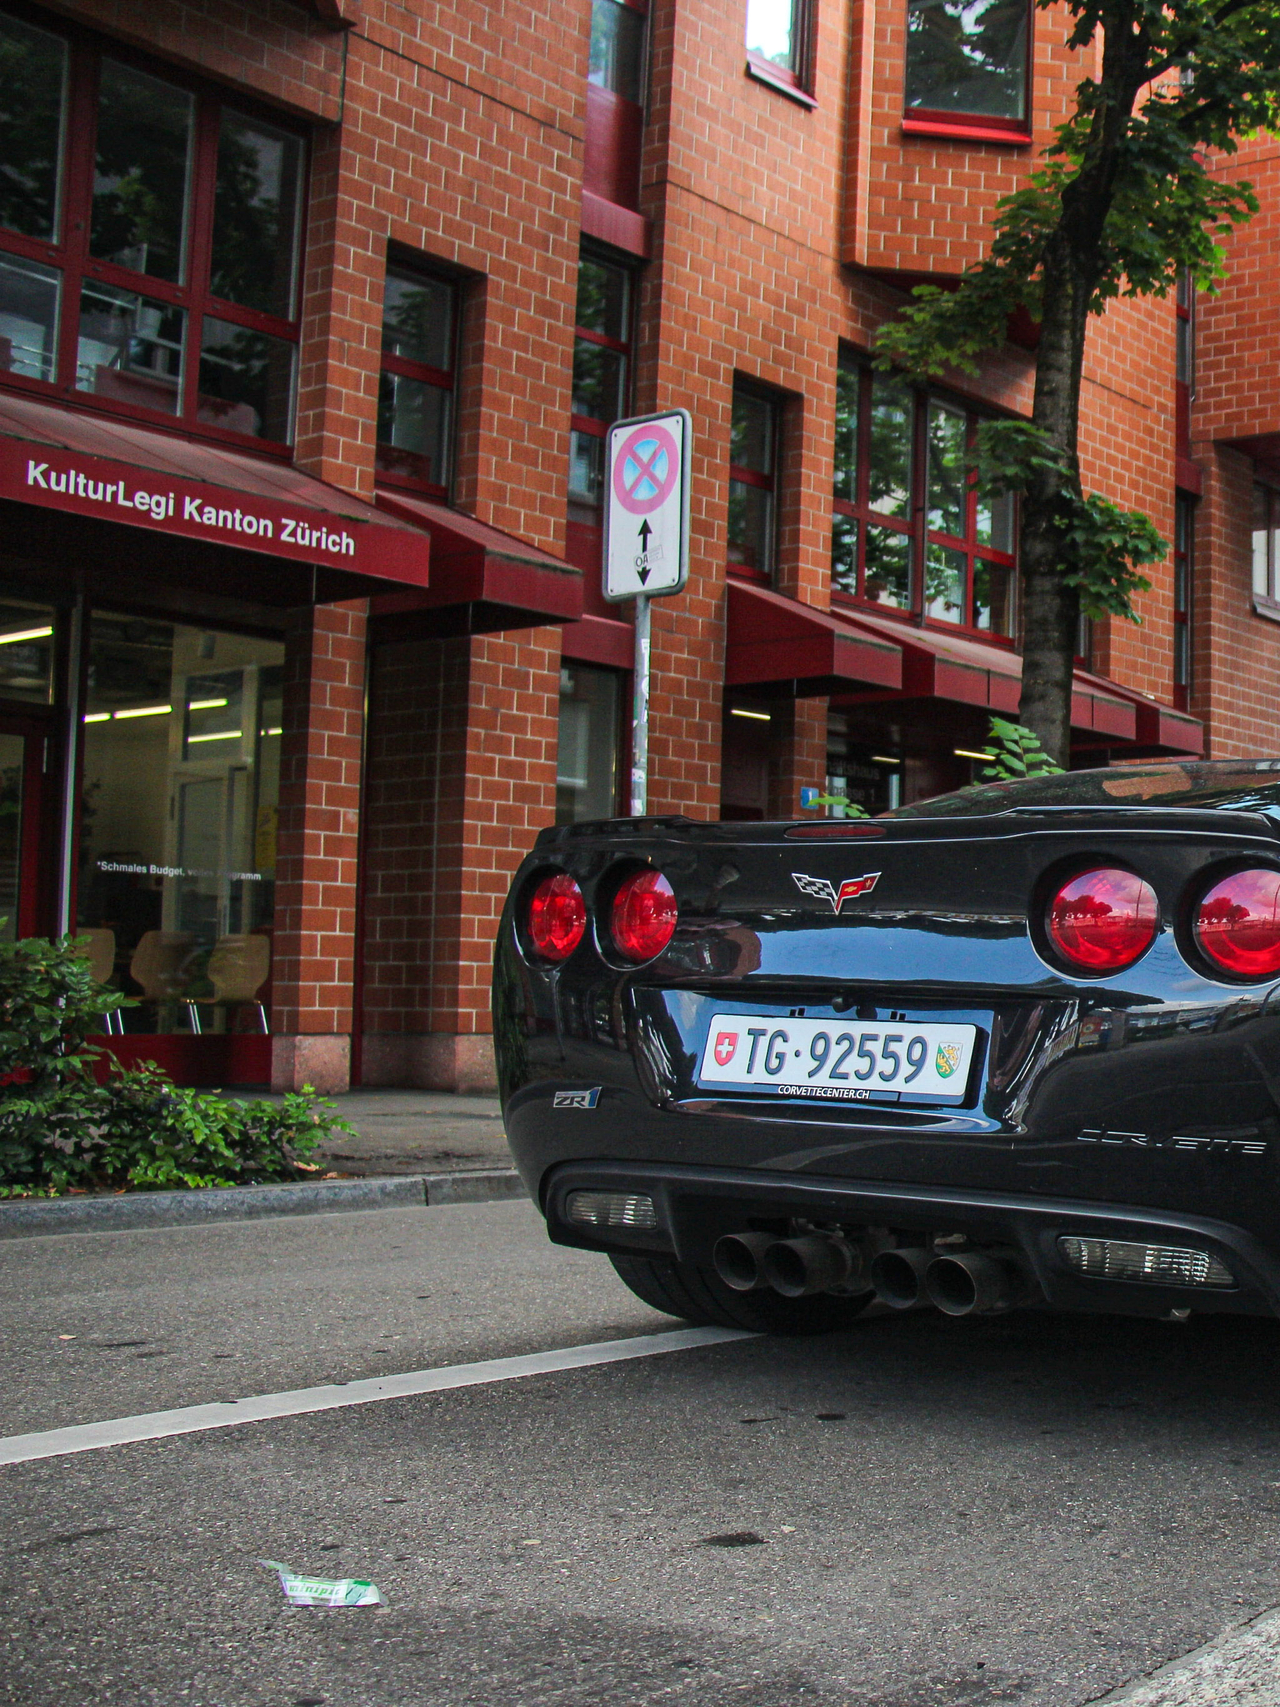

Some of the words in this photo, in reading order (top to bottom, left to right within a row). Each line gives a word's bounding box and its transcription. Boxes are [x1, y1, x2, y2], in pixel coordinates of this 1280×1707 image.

[27, 460, 175, 521] KulturLegi
[183, 496, 274, 538] Kanton
[280, 518, 356, 556] Zürich
[554, 1086, 602, 1108] ZR1
[777, 1084, 871, 1100] CORVETTECENTER.CH
